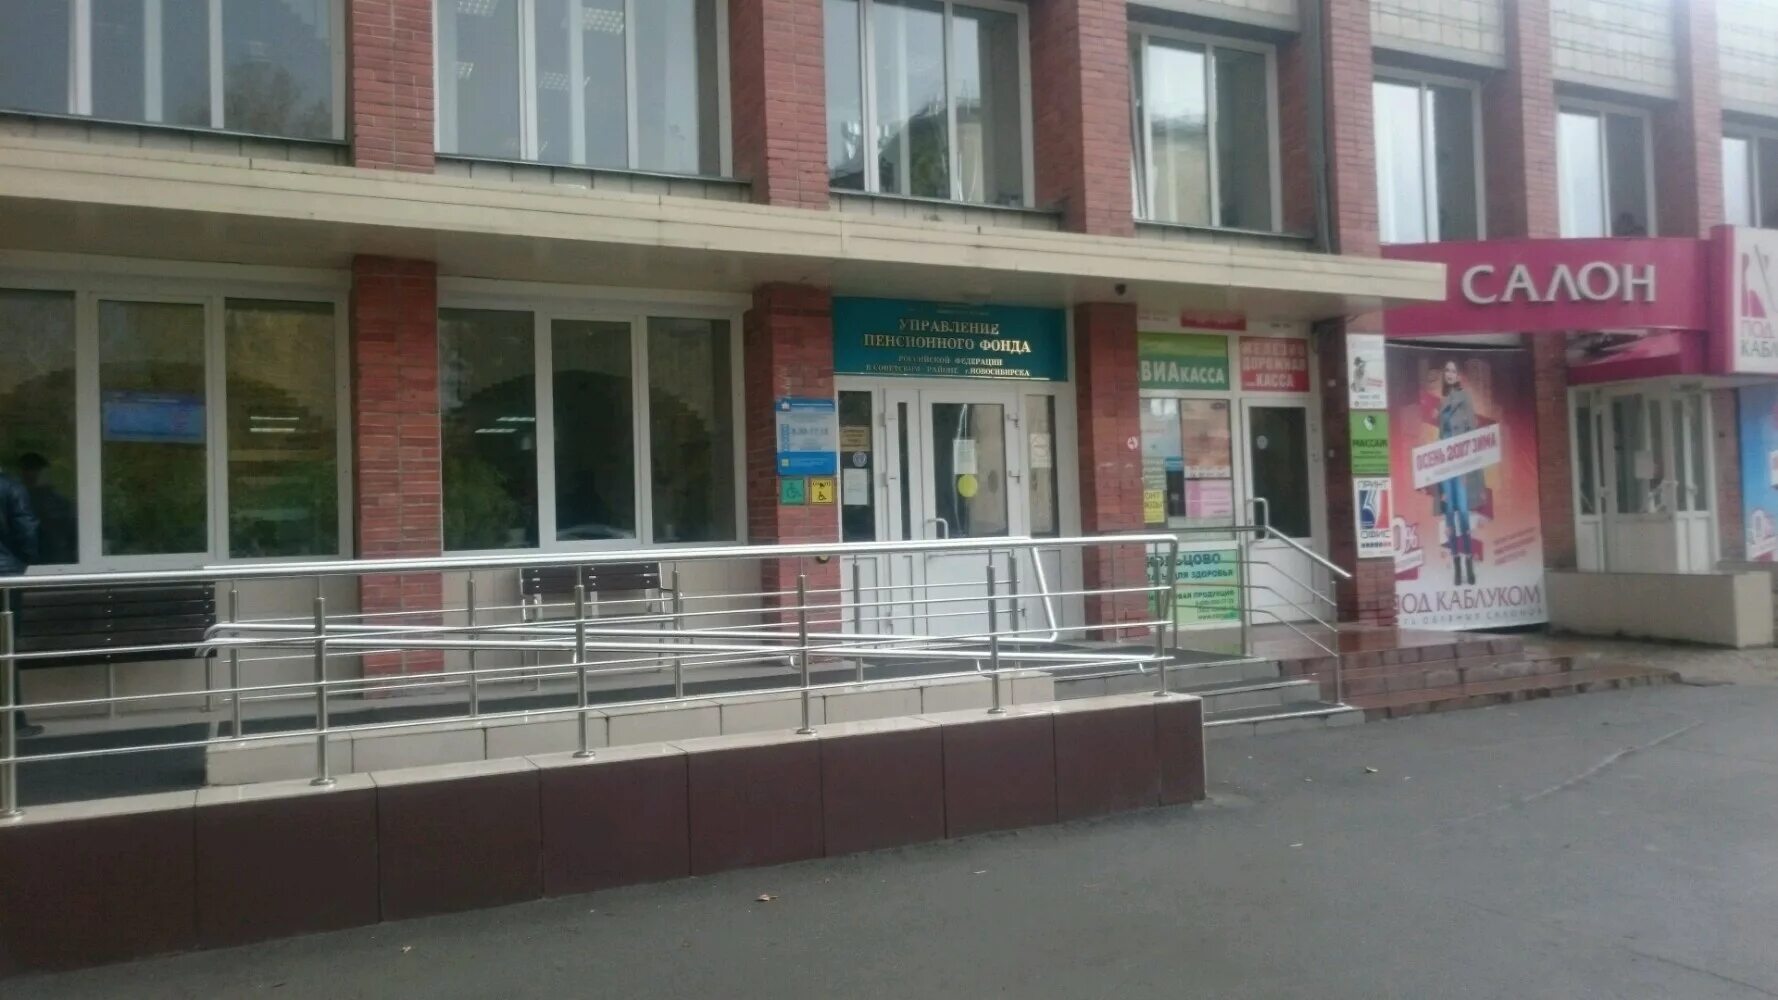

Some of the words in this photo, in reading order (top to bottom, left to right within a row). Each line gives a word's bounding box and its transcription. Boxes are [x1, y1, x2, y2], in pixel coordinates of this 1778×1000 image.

[1461, 262, 1656, 304] САЛОН
[899, 318, 999, 335] УПРАВЛЕНИЕ
[1741, 321, 1777, 338] ПОД
[864, 334, 974, 350] ПЕНСИОННОГО
[979, 339, 1032, 354] ФОНДА
[955, 357, 1003, 367] ФЕДЕРАЦИИ
[1255, 373, 1295, 387] КАССА
[1416, 448, 1446, 472] ОСЕНЬ
[1191, 569, 1234, 579] ЗДОРОВЬЯ
[1436, 584, 1541, 611] КАБЛУКОМ
